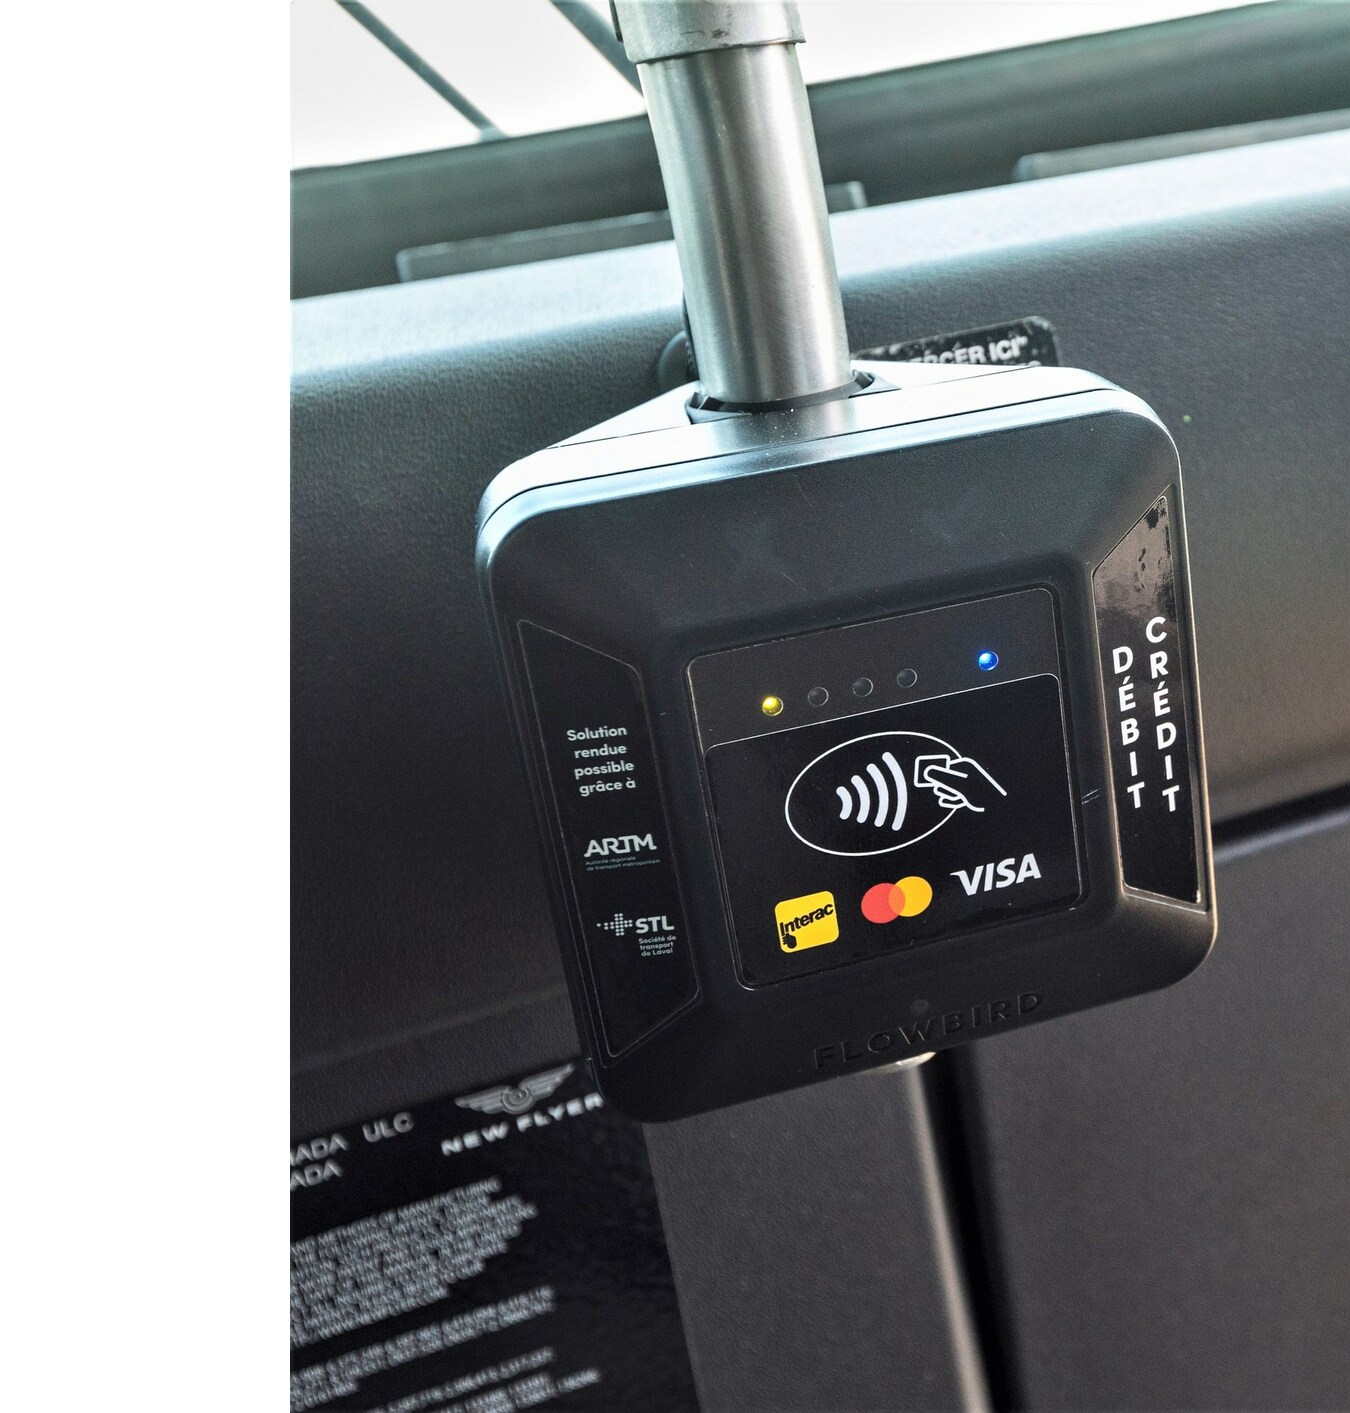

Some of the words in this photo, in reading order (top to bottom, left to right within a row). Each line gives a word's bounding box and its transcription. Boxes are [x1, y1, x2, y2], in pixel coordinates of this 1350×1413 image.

[1145, 616, 1181, 813] CRÉDIT
[566, 725, 628, 741] Solution
[1112, 645, 1146, 809] DÉBIT
[574, 743, 627, 759] rendue
[574, 760, 635, 780] possible
[579, 779, 623, 797] grâce
[625, 777, 637, 790] à
[584, 833, 658, 858] ARTM
[950, 853, 1043, 896] VISA
[635, 915, 675, 934] STL
[779, 902, 835, 936] Interac
[638, 936, 665, 945] Société
[640, 941, 674, 951] transport
[652, 947, 673, 956] Laval
[813, 992, 1042, 1070] FLOWBIRD
[441, 1121, 508, 1157] NEW
[515, 1091, 604, 1133] FLYER
